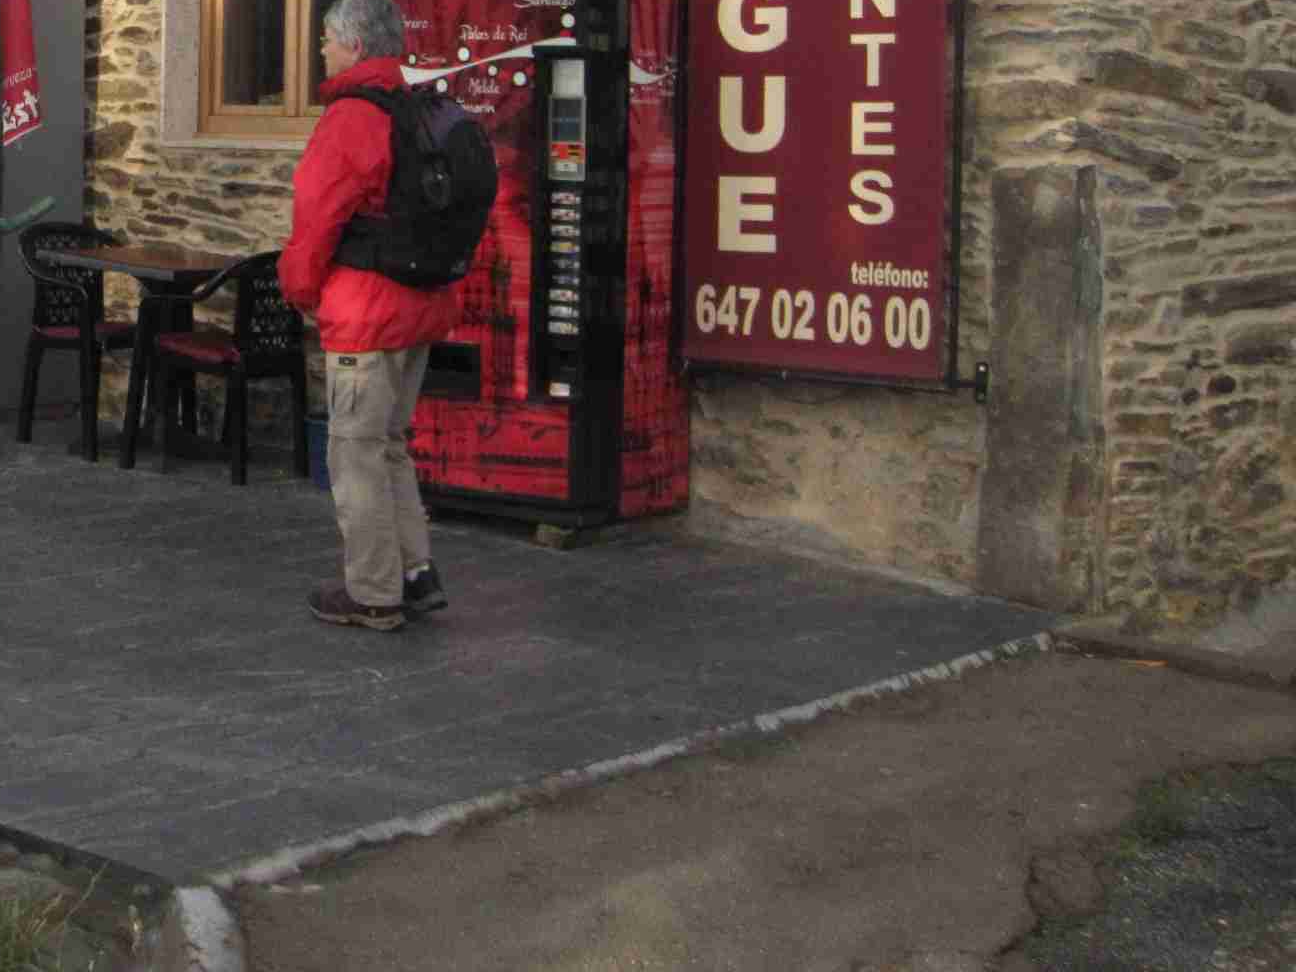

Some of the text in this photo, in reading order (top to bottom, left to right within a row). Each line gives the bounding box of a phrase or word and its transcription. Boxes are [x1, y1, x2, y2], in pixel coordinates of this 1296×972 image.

[492, 23, 506, 41] de
[507, 24, 529, 44] Rei
[850, 261, 929, 289] teléfono:
[695, 283, 932, 351] 647 02 06 00
